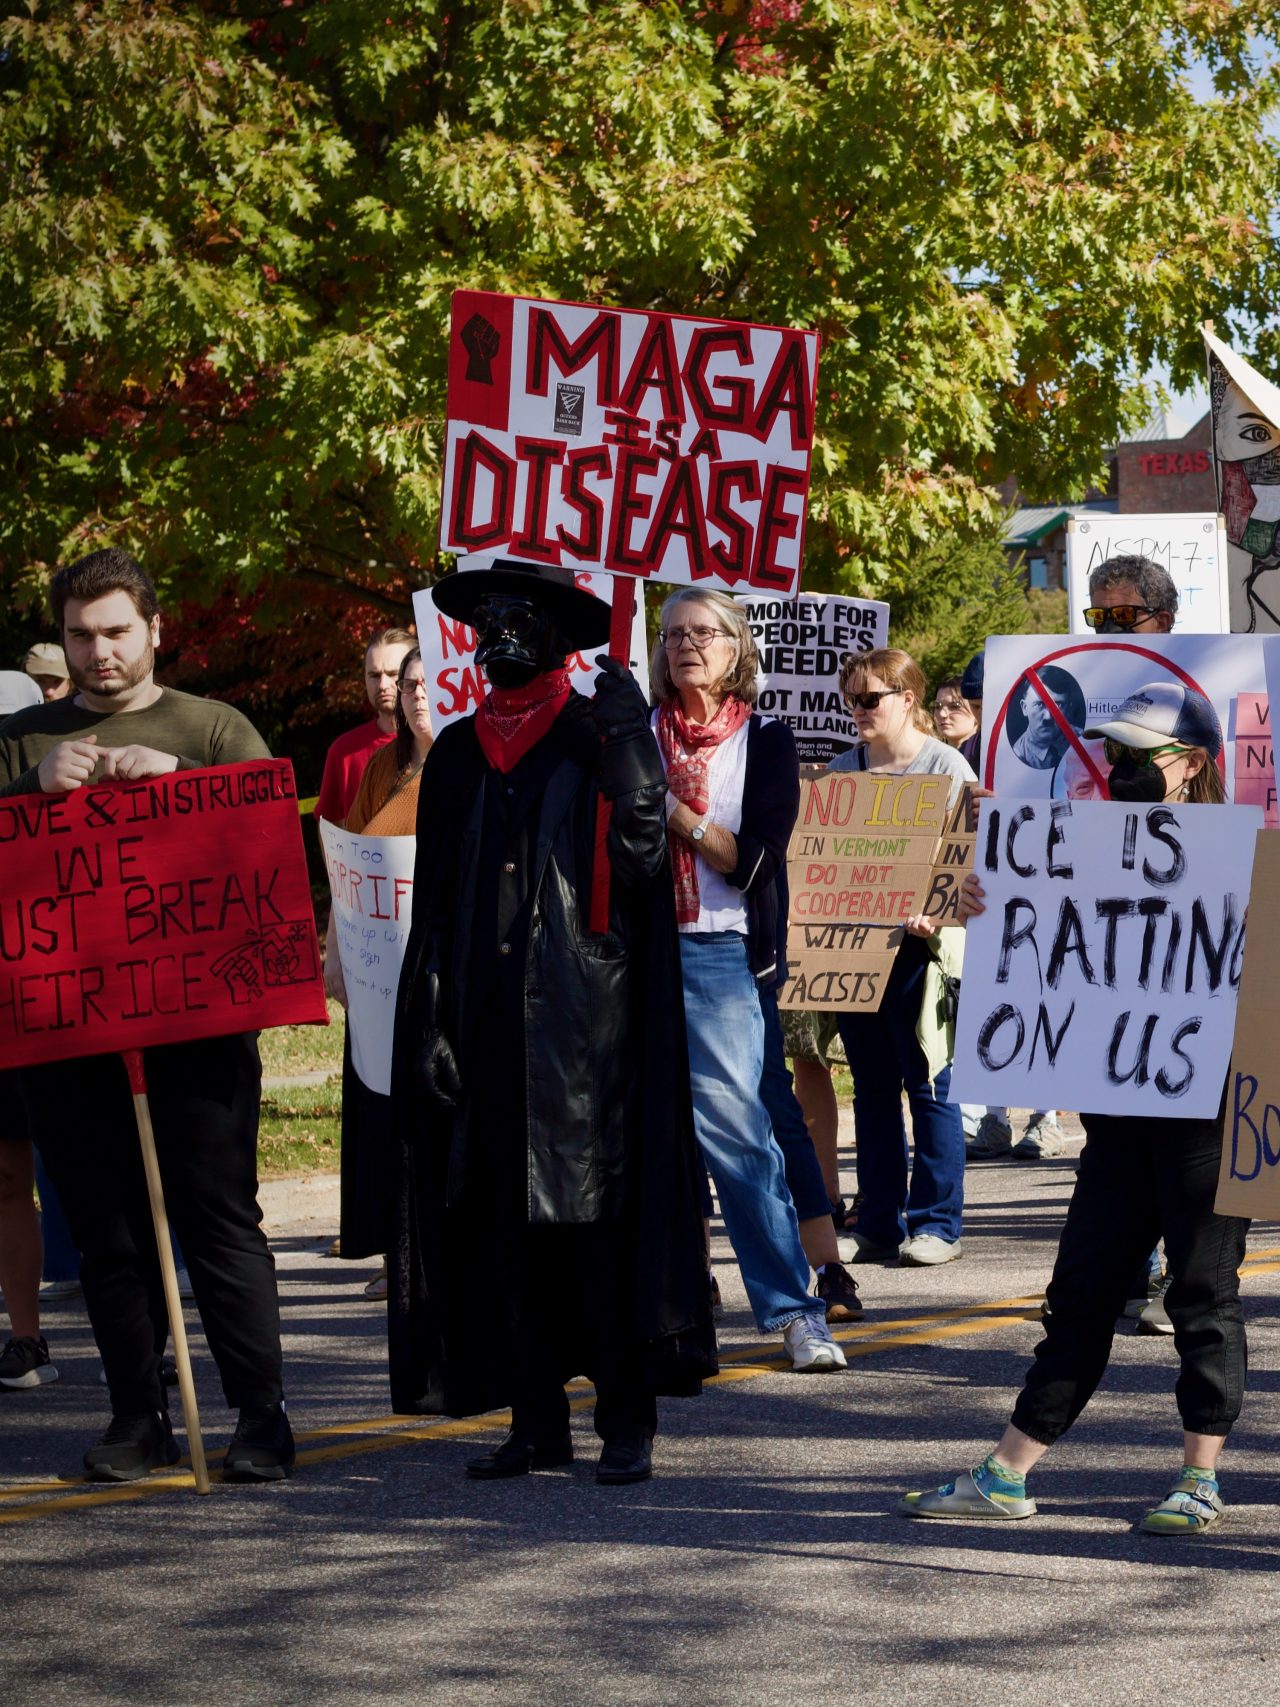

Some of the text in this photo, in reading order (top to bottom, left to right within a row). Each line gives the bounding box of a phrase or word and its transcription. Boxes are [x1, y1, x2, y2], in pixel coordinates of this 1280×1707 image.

[528, 308, 811, 447] MAGA
[606, 412, 721, 463] IS A
[1139, 452, 1211, 476] TEXAS
[448, 431, 806, 592] DISEASE
[747, 602, 877, 629] MONEY FOR
[752, 689, 792, 711] OT
[1089, 702, 1121, 713] Hitle
[84, 790, 120, 828] &
[174, 768, 296, 815] STRUGGLE
[804, 778, 856, 825] NO
[799, 836, 911, 857] IN VERMONT
[943, 844, 968, 865] IN
[984, 801, 1074, 880] ICE
[1121, 805, 1190, 887] IS
[53, 835, 147, 893] WE
[806, 864, 893, 885] DO NOT
[124, 867, 284, 945] BREAK
[794, 891, 916, 917] COOPERATE
[362, 928, 376, 949] up
[804, 926, 869, 949] WITH
[359, 948, 381, 968] sign
[116, 951, 208, 1020] ICE
[380, 985, 392, 1000] up
[976, 999, 1203, 1098] ON US
